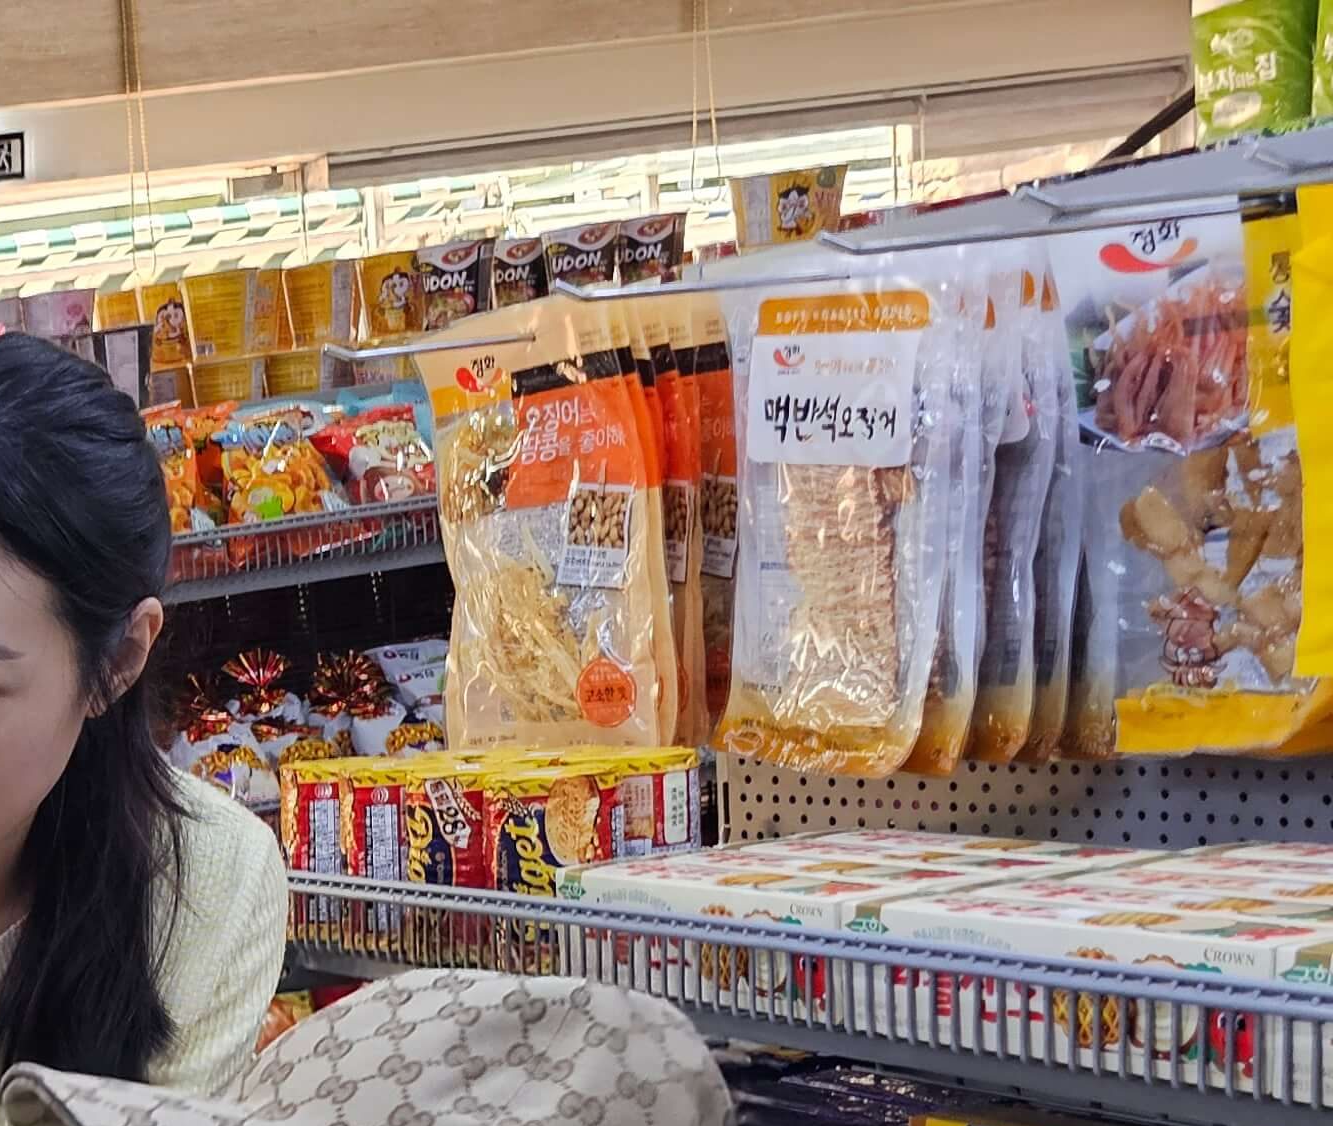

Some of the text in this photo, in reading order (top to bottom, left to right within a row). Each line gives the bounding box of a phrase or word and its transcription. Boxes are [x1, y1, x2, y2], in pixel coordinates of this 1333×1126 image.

[554, 255, 604, 274] UDON
[423, 271, 466, 292] UDON
[495, 266, 532, 284] DON
[789, 903, 822, 918] CROWN
[1202, 947, 1255, 967] CROWN
